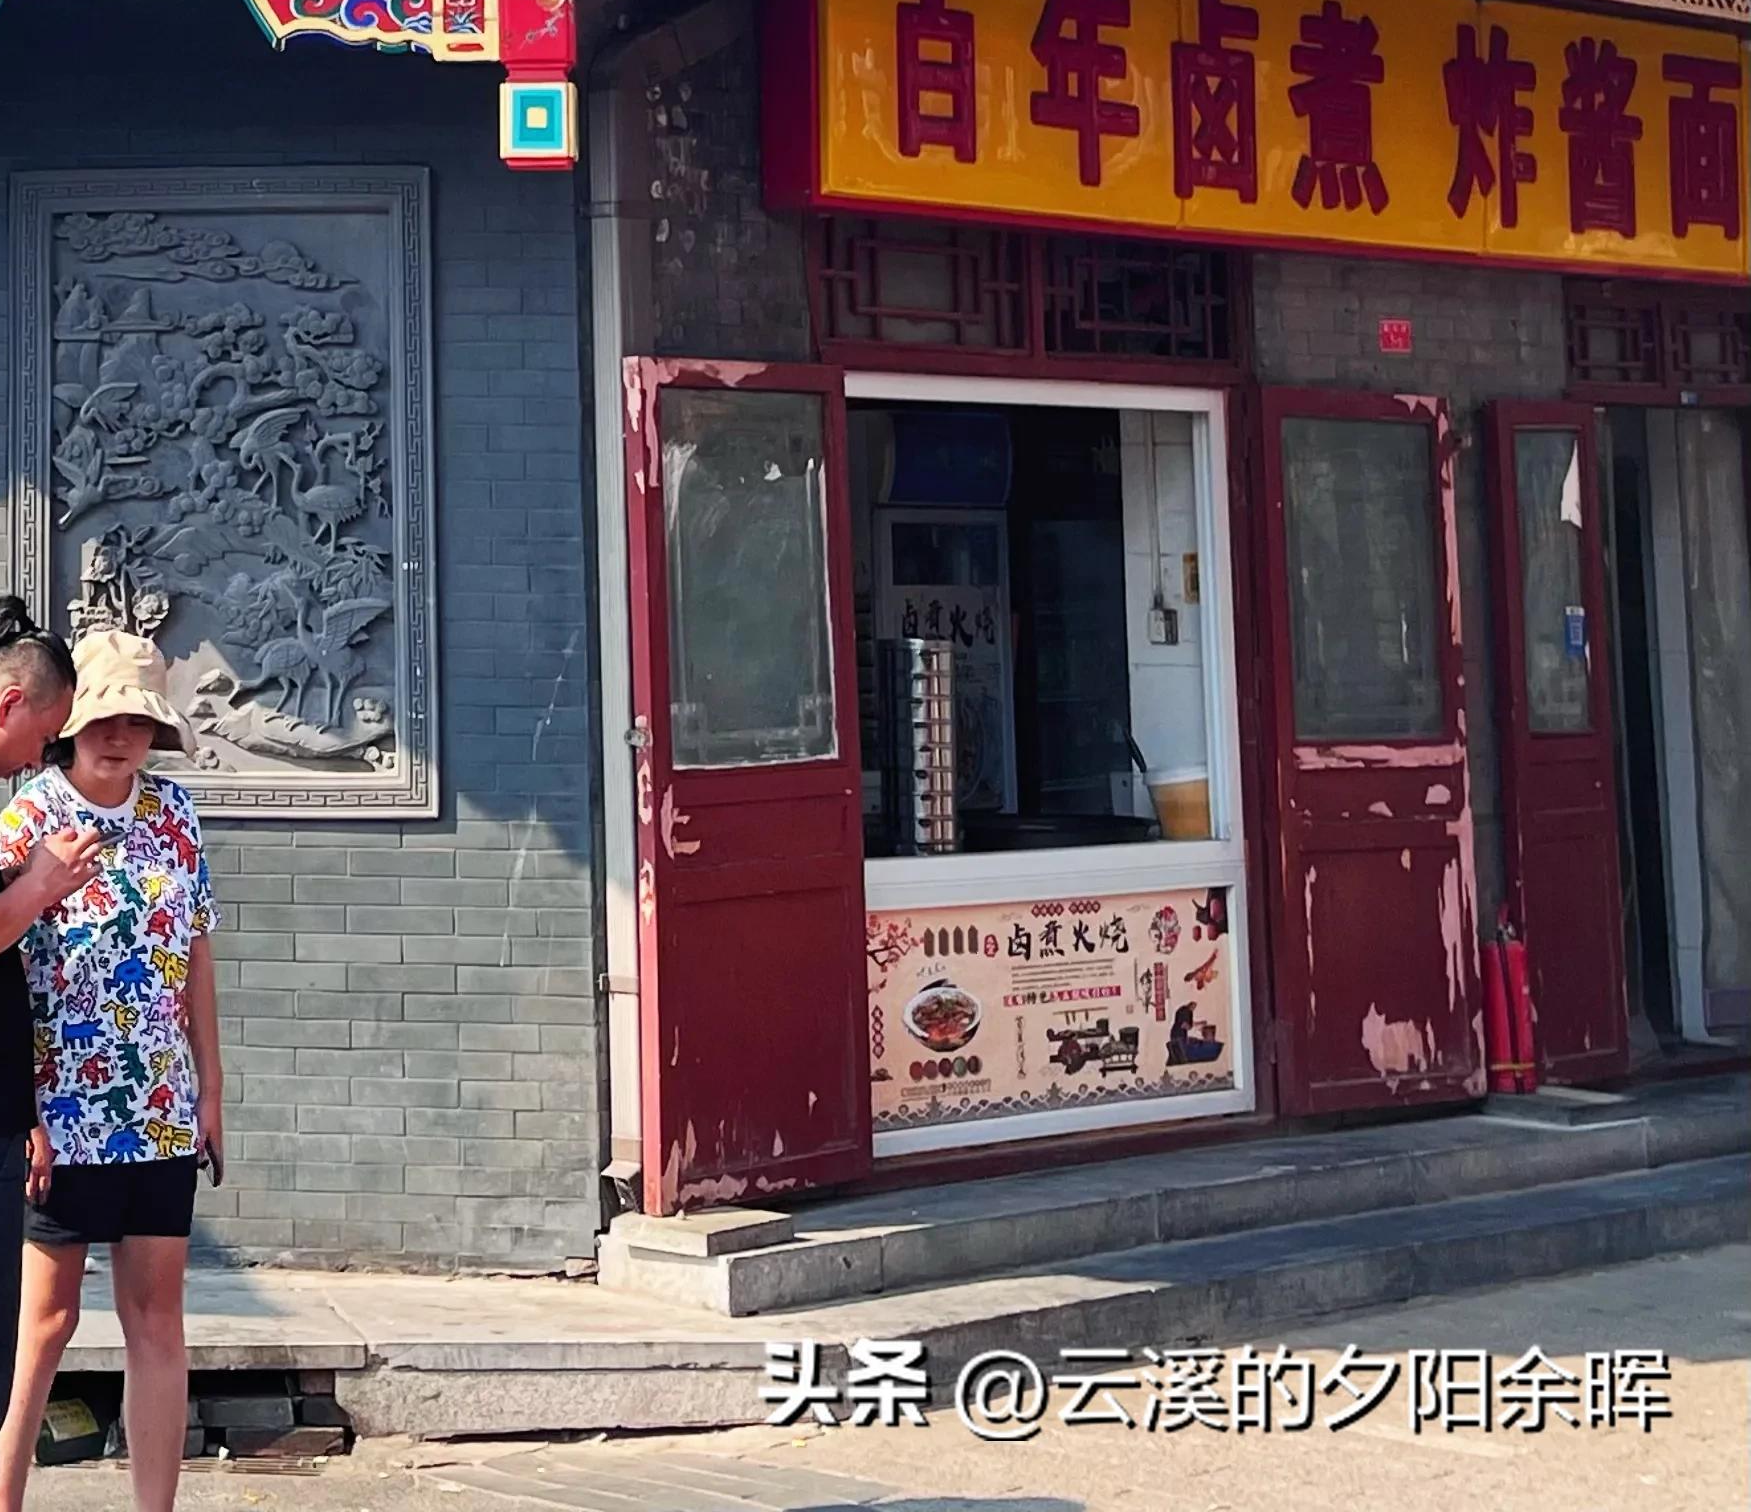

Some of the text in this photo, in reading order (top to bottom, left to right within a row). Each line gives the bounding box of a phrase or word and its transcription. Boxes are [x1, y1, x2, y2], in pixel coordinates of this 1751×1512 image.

[1443, 22, 1743, 239] 炸酱面
[1007, 912, 1129, 961] 卤煮火烧
